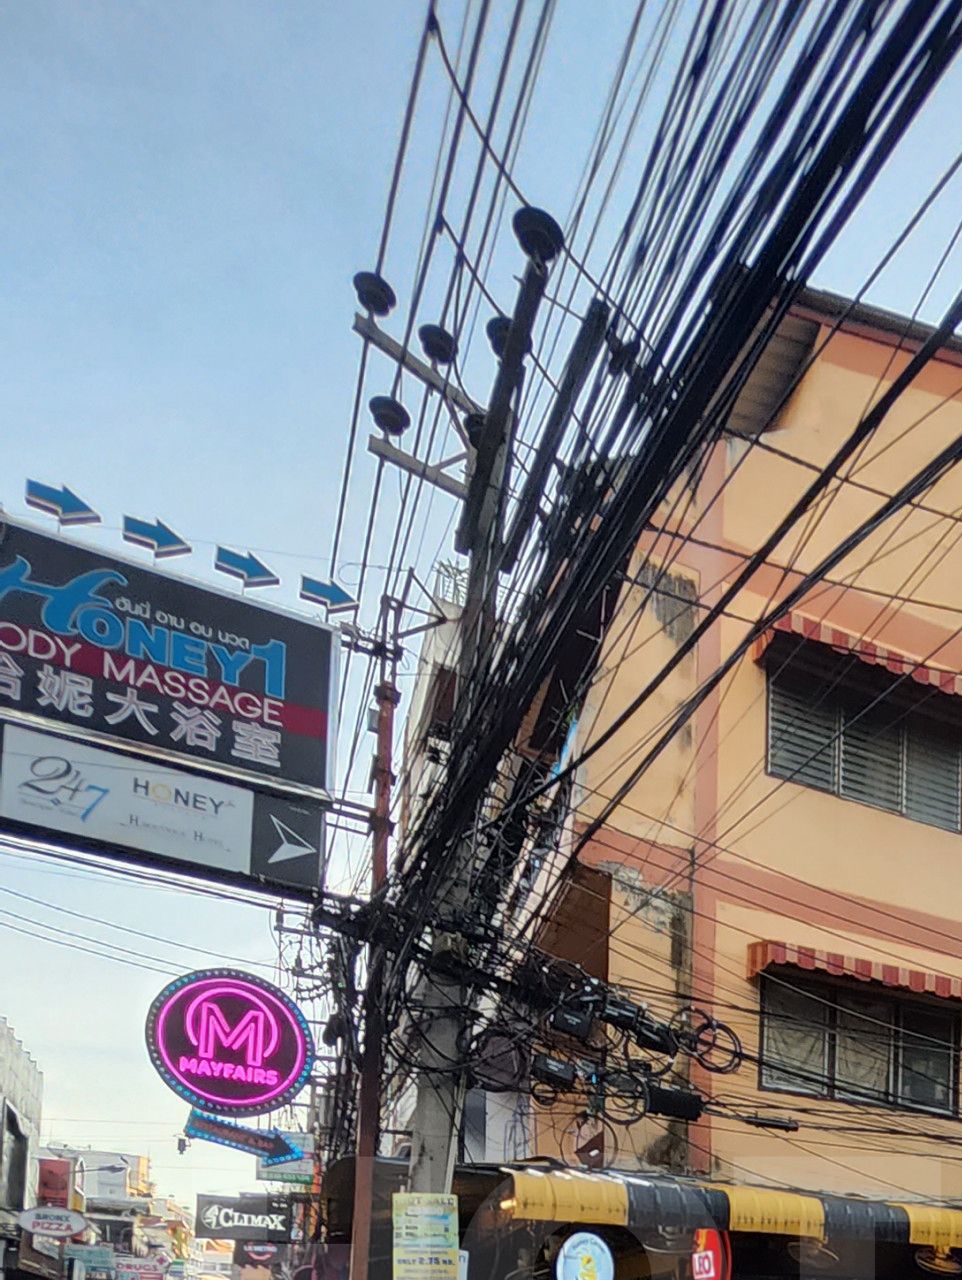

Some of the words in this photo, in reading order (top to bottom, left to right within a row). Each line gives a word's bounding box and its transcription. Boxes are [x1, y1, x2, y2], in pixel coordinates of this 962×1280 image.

[0, 621, 82, 667] ODY
[102, 651, 284, 728] MASSAGE
[132, 776, 225, 815] HONEY
[179, 1056, 281, 1086] MAYFAIRS
[31, 1220, 74, 1232] PIZZA
[219, 1207, 287, 1232] CLIMAX
[116, 1263, 159, 1272] DRUGS
[694, 1252, 712, 1275] LEO
